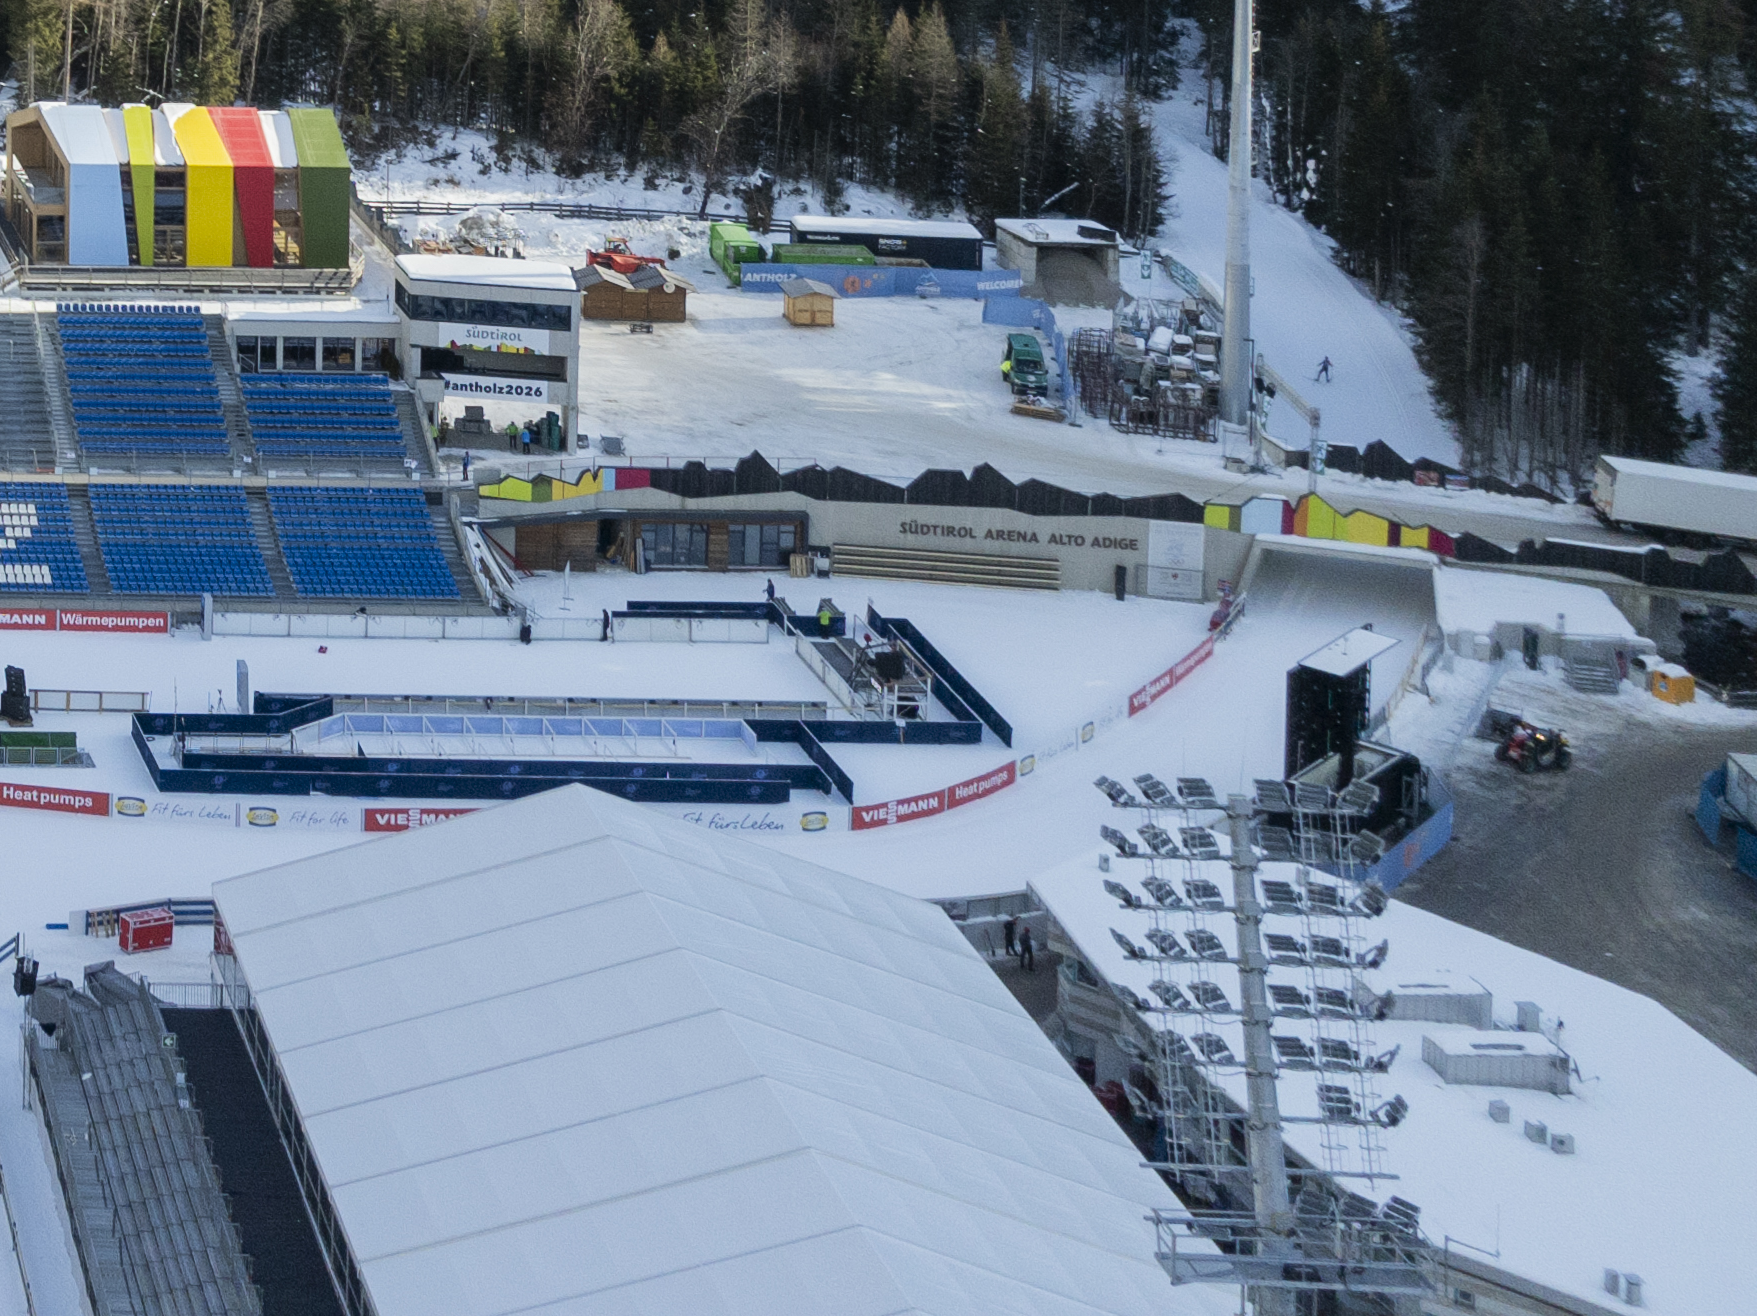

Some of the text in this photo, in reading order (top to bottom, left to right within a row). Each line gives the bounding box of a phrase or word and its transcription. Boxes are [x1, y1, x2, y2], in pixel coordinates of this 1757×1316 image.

[743, 272, 798, 284] ANTHOLZ
[976, 279, 1021, 291] WELCOME
[444, 380, 543, 398] #antholz2026
[899, 520, 1140, 551] SÜDTIROL ARENA ALTO ADIGE
[61, 613, 164, 628] Wärmepumpen
[955, 770, 1008, 800] Heat pumps
[3, 786, 93, 809] Heat pumps
[861, 796, 938, 824] VIESSMANN
[740, 813, 784, 830] Leben
